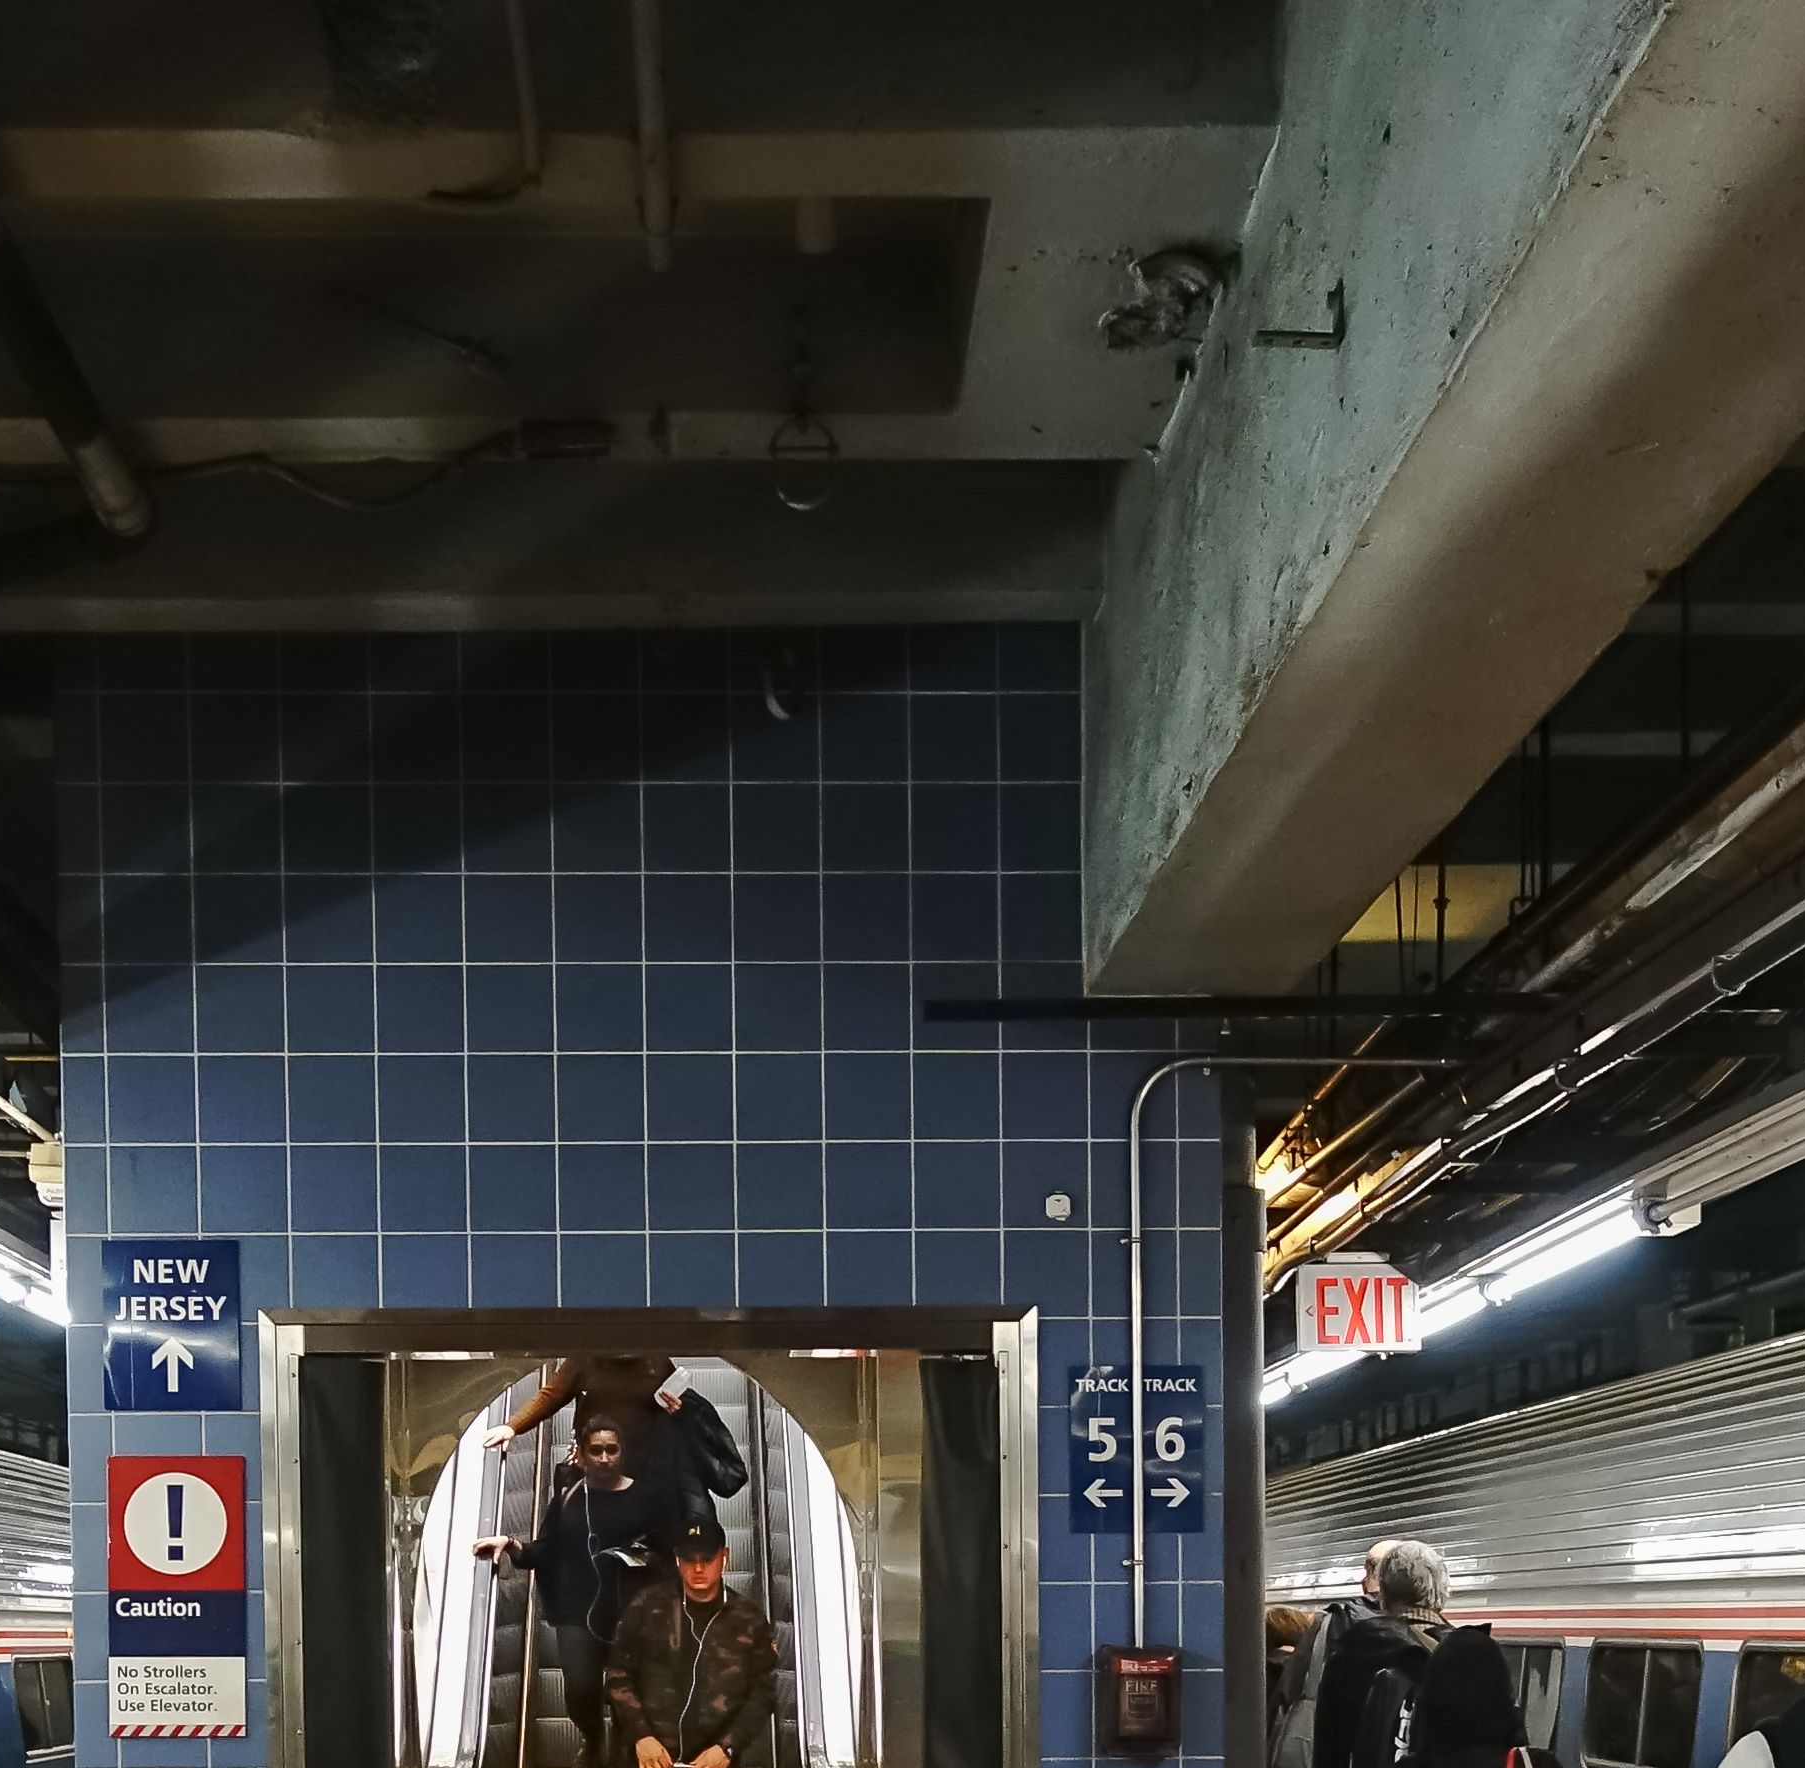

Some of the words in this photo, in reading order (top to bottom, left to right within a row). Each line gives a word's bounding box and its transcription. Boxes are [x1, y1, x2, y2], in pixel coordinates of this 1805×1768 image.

[133, 1259, 210, 1284] NEW
[114, 1296, 227, 1321] JERSEY
[1315, 1277, 1409, 1345] EXIT
[1075, 1378, 1130, 1392] TRACK
[1143, 1378, 1198, 1392] TRACK
[1088, 1417, 1117, 1462] 5
[1155, 1416, 1186, 1462] 6
[115, 1596, 201, 1617] Caution
[117, 1665, 139, 1678] No
[143, 1664, 207, 1678] Strollers
[117, 1682, 140, 1695] On
[145, 1682, 218, 1695] Escalator.
[117, 1699, 146, 1712] Use
[150, 1698, 218, 1712] Elevator.
